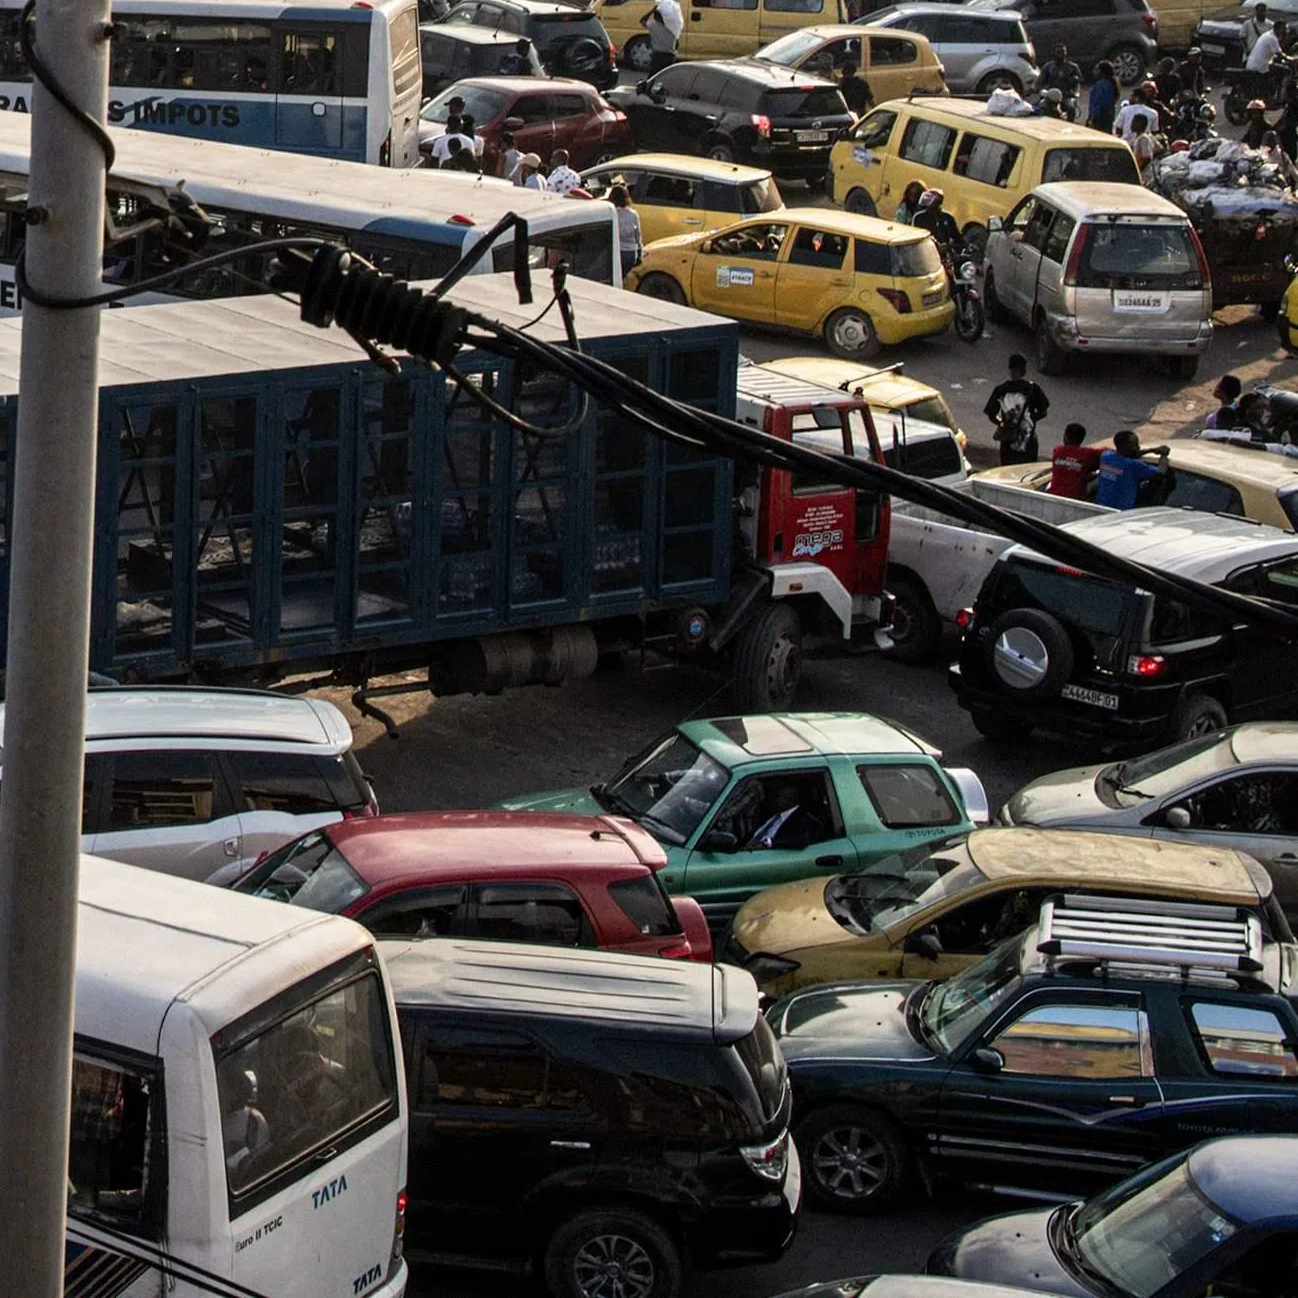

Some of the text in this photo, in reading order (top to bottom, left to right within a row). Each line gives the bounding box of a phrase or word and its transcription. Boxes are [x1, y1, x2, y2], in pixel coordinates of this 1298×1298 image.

[135, 101, 241, 128] IMPOTS
[311, 1175, 348, 1210] TATA
[235, 1215, 284, 1253] Euro II TCIC
[353, 1263, 382, 1295] TATA
